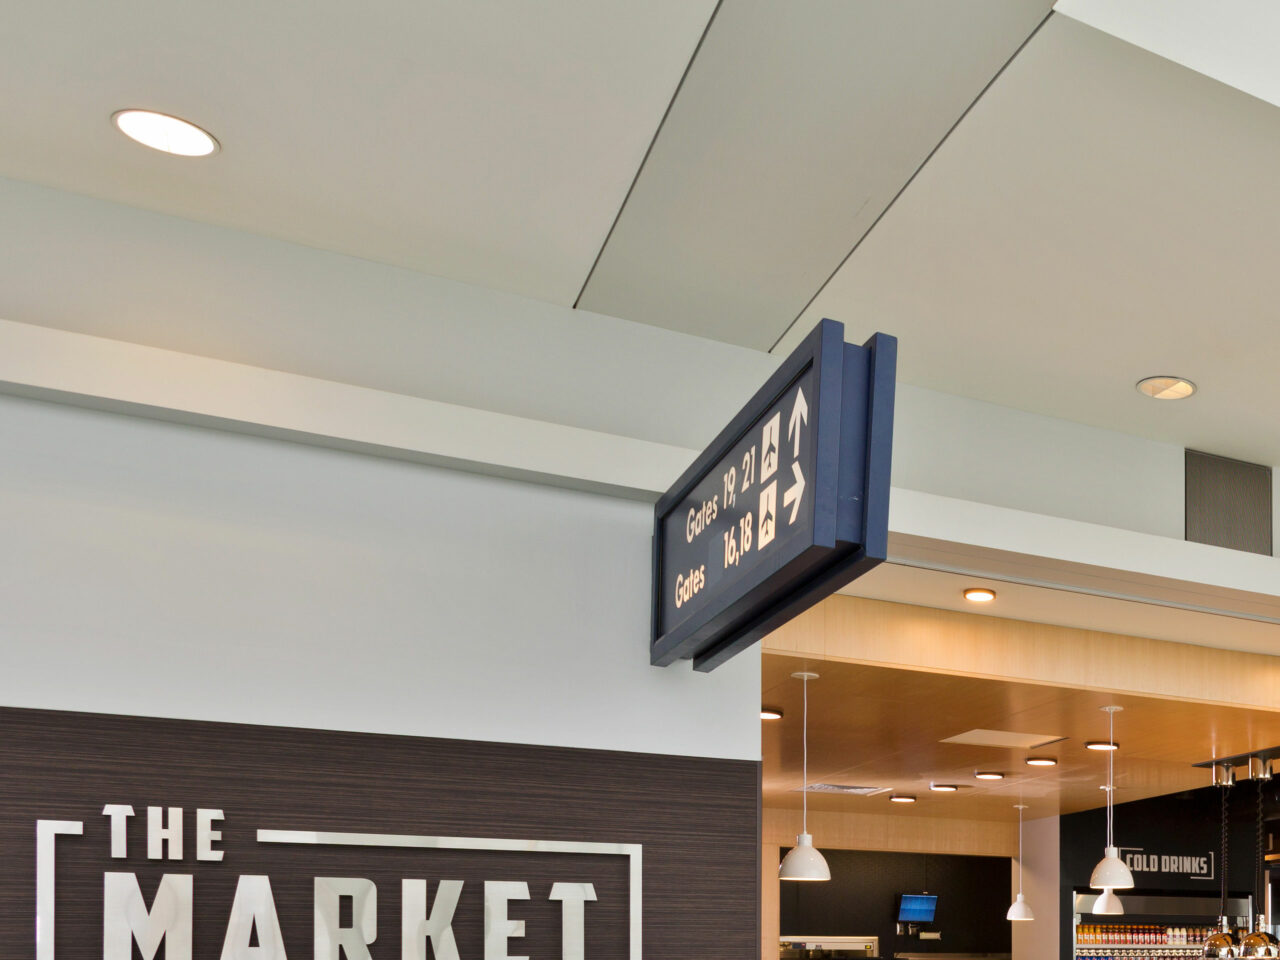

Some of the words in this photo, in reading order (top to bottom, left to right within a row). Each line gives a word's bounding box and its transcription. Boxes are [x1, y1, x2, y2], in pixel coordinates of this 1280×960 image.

[686, 495, 719, 543] Gates
[741, 445, 756, 493] 21
[675, 565, 705, 608] Gates
[102, 803, 226, 862] THE
[1125, 853, 1159, 872] COLD
[1161, 855, 1208, 874] DRINKS
